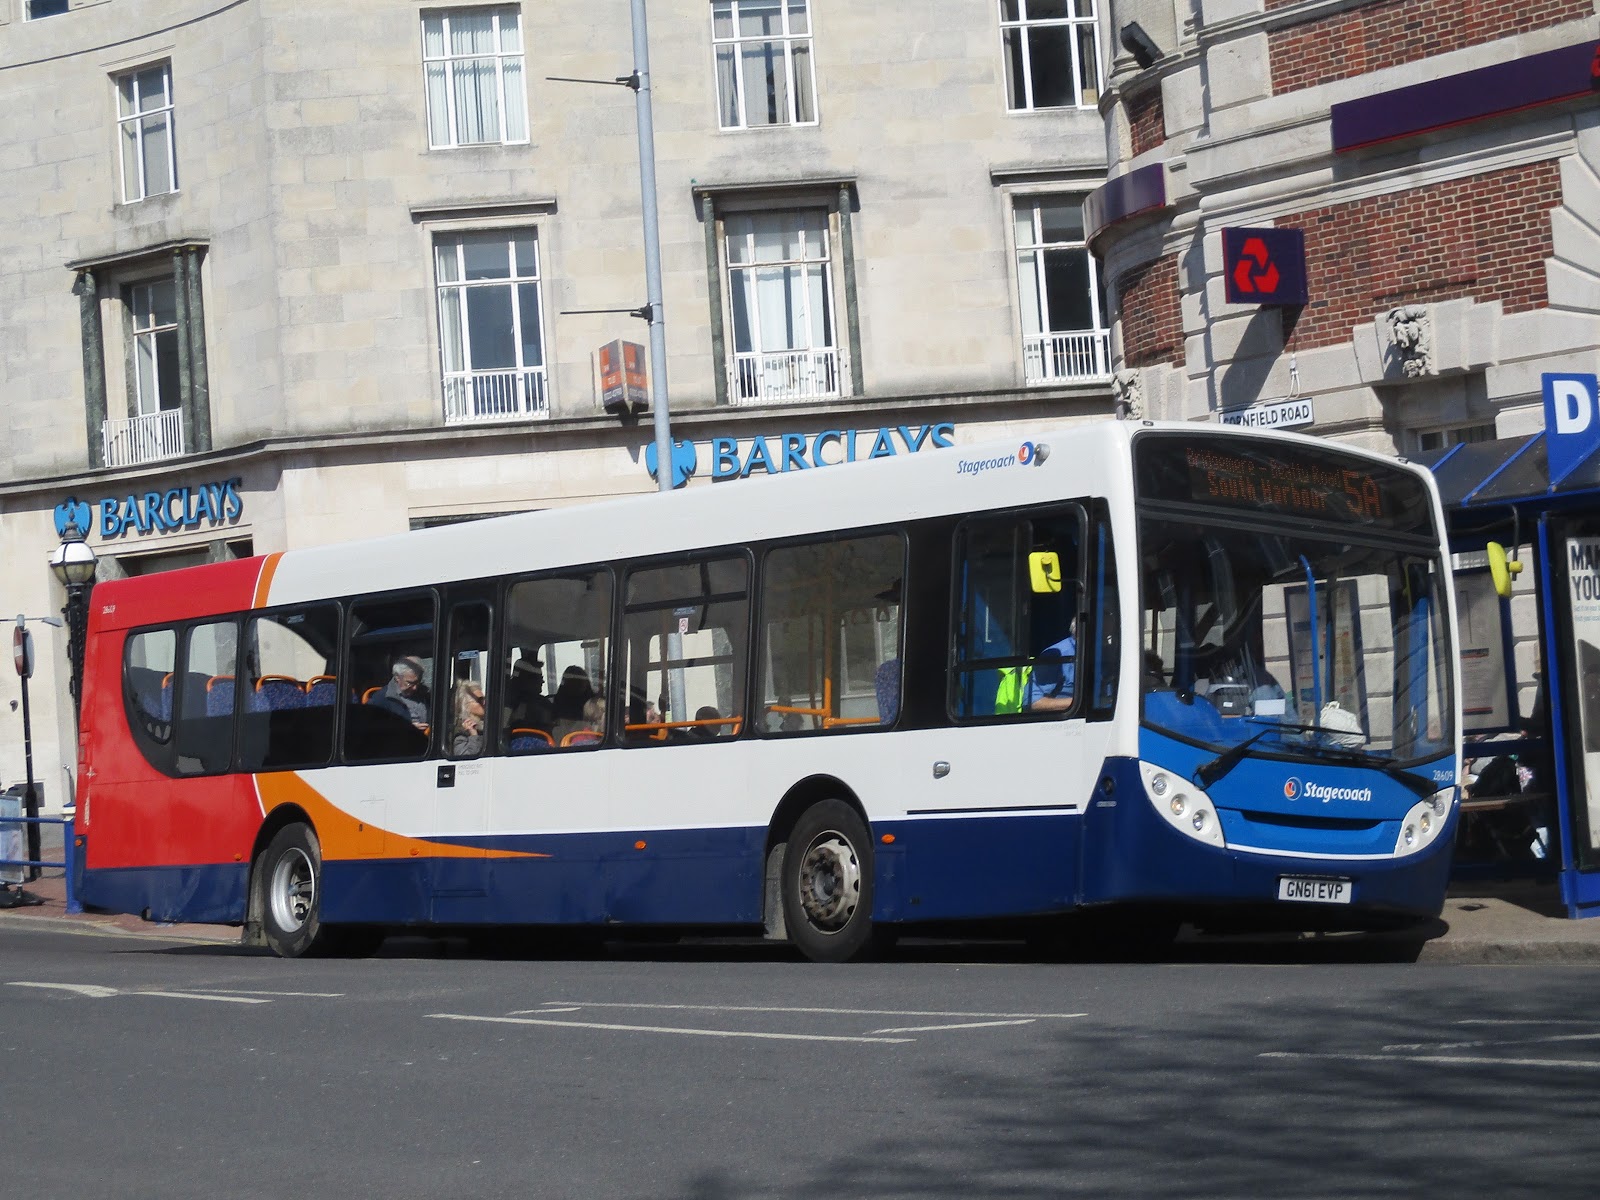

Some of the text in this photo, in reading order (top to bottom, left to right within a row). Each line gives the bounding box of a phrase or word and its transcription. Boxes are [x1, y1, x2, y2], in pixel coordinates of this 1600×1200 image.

[1281, 405, 1310, 422] ROAD
[1552, 380, 1592, 434] D
[712, 423, 955, 477] BARCLAYS
[957, 454, 1016, 475] Stagecoach
[1207, 470, 1257, 502] South
[1342, 469, 1382, 517] 5A
[100, 478, 242, 537] BARCLAYS
[1433, 769, 1454, 781] 28609
[1304, 782, 1372, 803] Stagecoach
[1286, 881, 1343, 900] GN61 EVP
